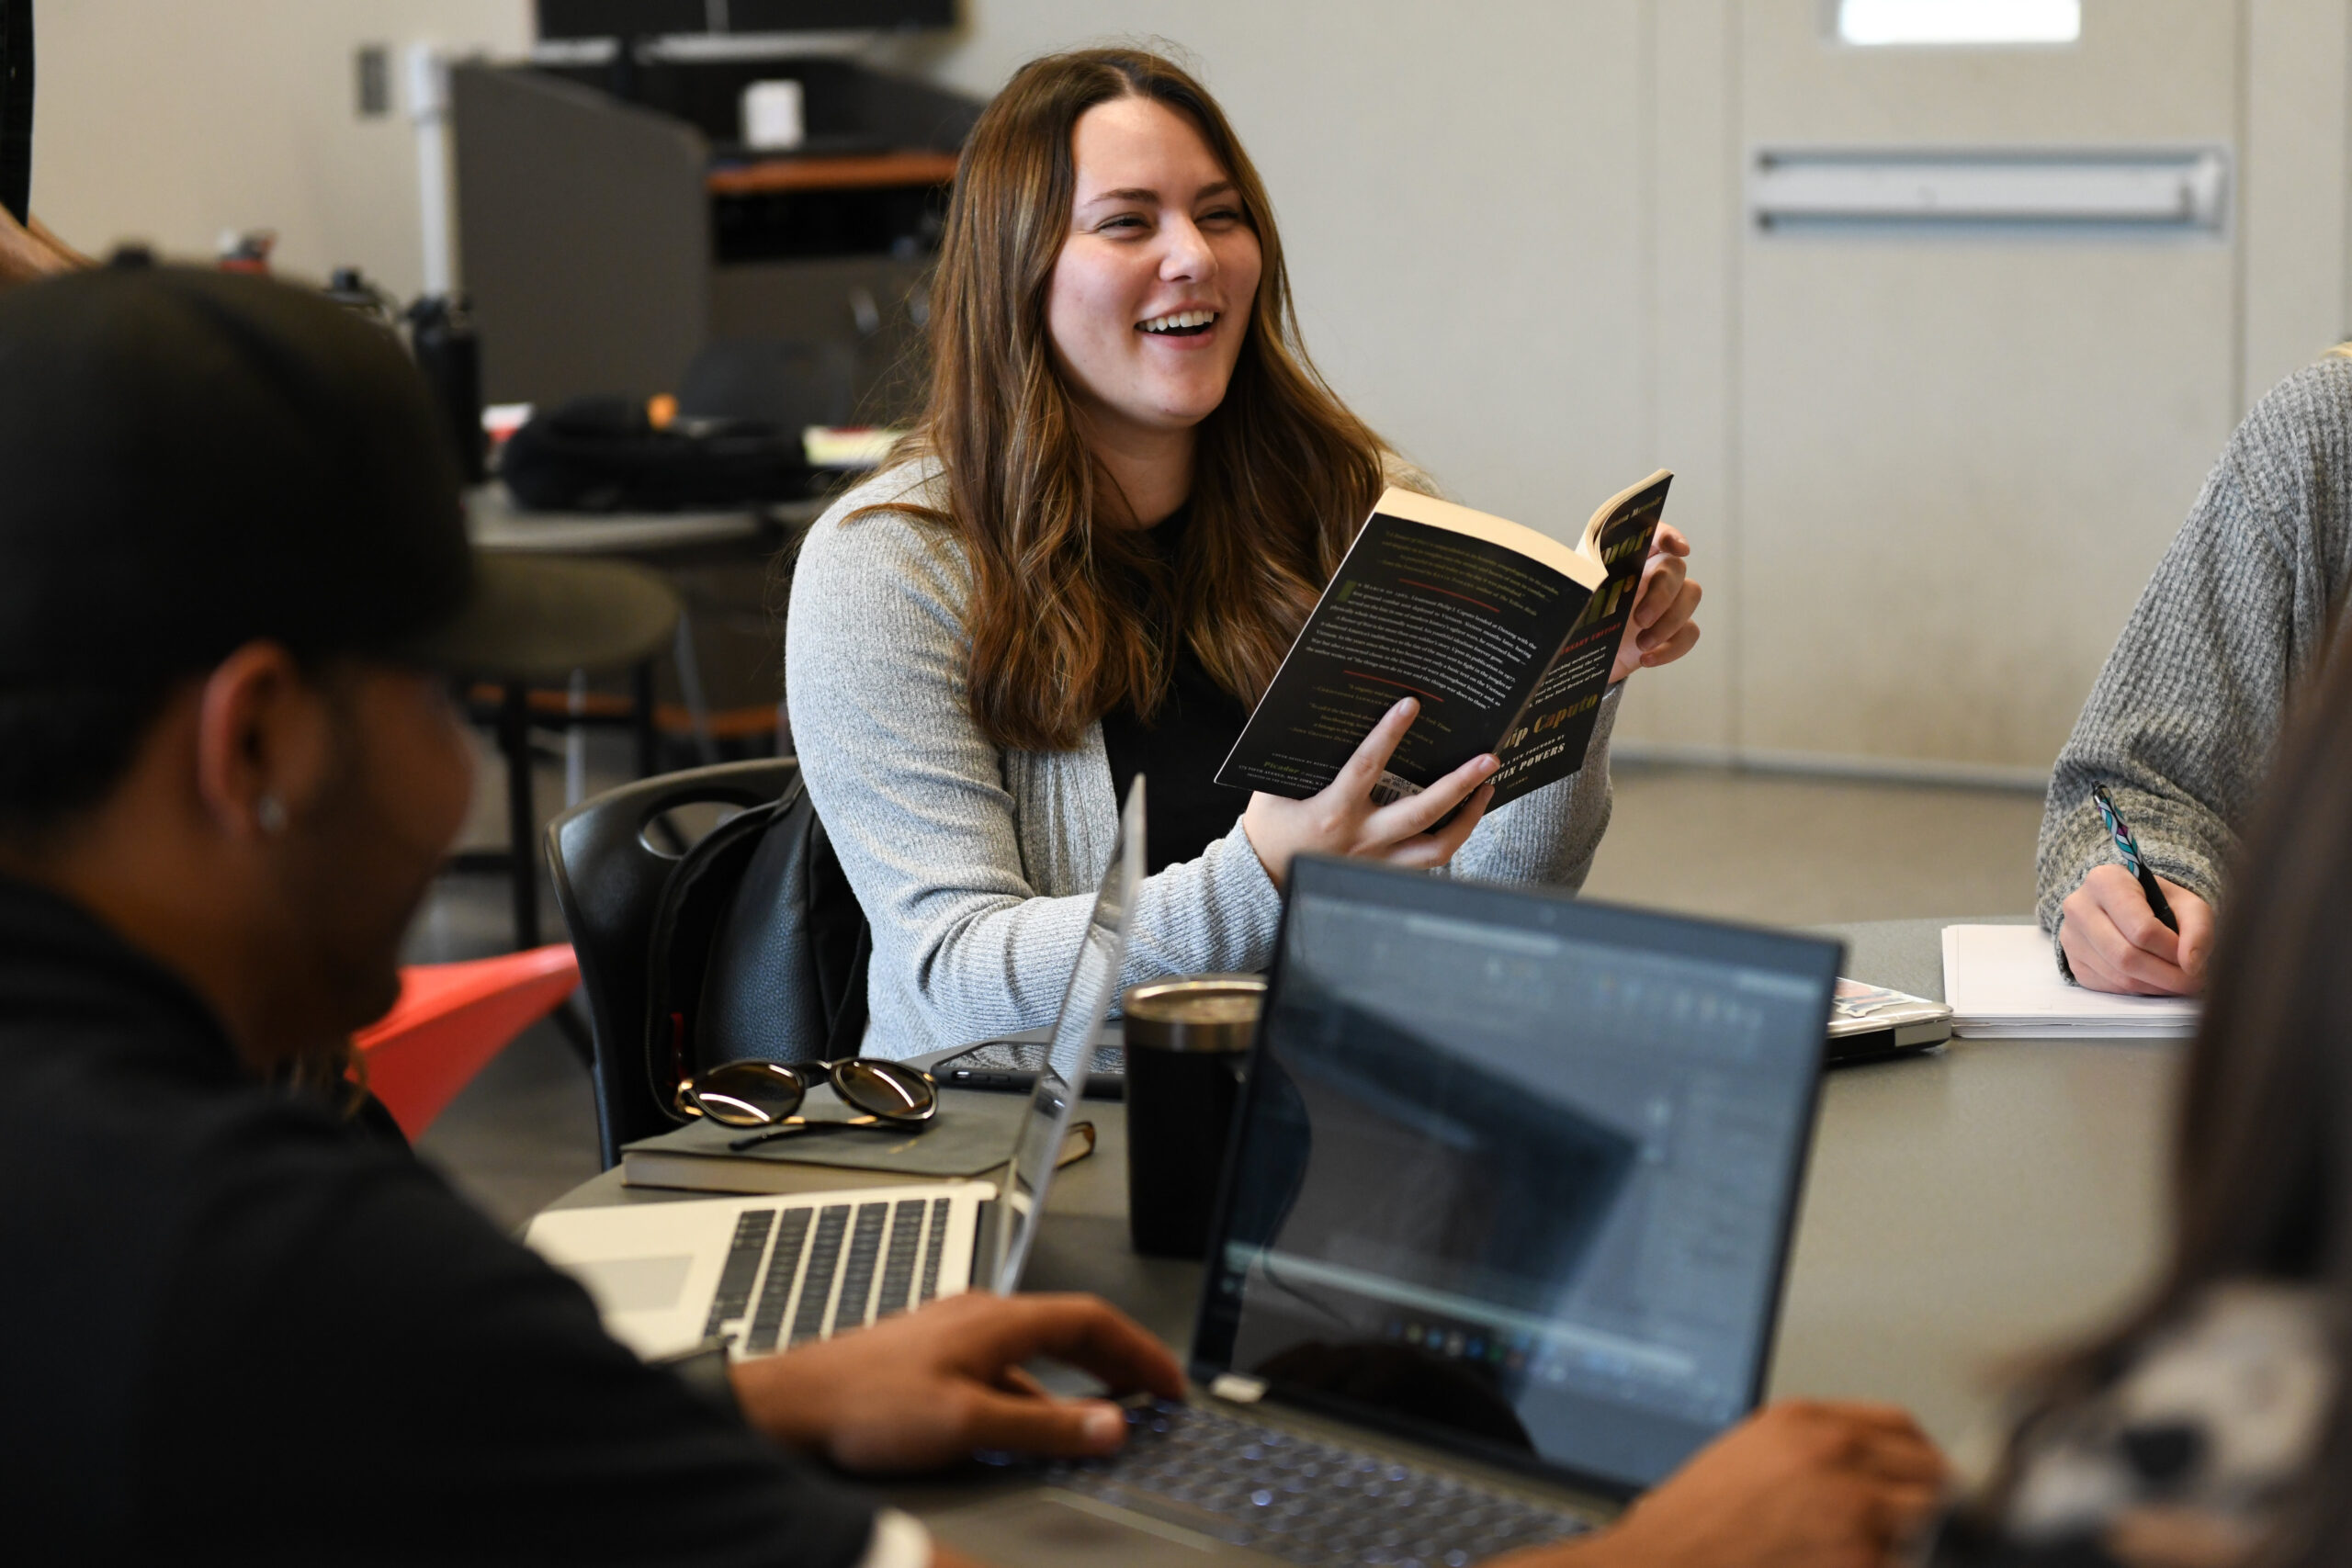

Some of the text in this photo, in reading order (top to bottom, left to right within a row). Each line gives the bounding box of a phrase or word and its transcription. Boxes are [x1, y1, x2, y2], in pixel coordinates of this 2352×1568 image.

[1456, 609, 1474, 617] Caputo
[1475, 615, 1491, 625] landed
[1498, 626, 1516, 638] Danang
[1591, 622, 1620, 640] EDITION
[1431, 631, 1453, 639] youthful
[1453, 637, 1473, 649] idealism
[1474, 646, 1490, 656] forever
[1442, 614, 1462, 624] Vietnam.
[1464, 622, 1481, 631] Sixteen
[1483, 630, 1500, 640] months
[1515, 646, 1531, 658] having
[1486, 642, 1507, 654] returned
[1452, 647, 1464, 655] Upon
[1471, 657, 1498, 671] publication
[1504, 673, 1514, 682] 1977,
[1548, 661, 1570, 675] searching
[1572, 649, 1599, 664] meditations
[1568, 664, 1583, 673] among
[1594, 653, 1604, 661] most
[1430, 679, 1445, 688] things
[1440, 672, 1465, 686] throughout
[1466, 684, 1483, 696] history
[1447, 665, 1458, 673] basic
[1486, 683, 1505, 697] Vietnam
[1487, 675, 1505, 686] jungles
[1553, 676, 1570, 688] modern
[1534, 694, 1597, 732] Caputo
[1263, 761, 1300, 773] Picador
[1520, 742, 1565, 770] POWERS
